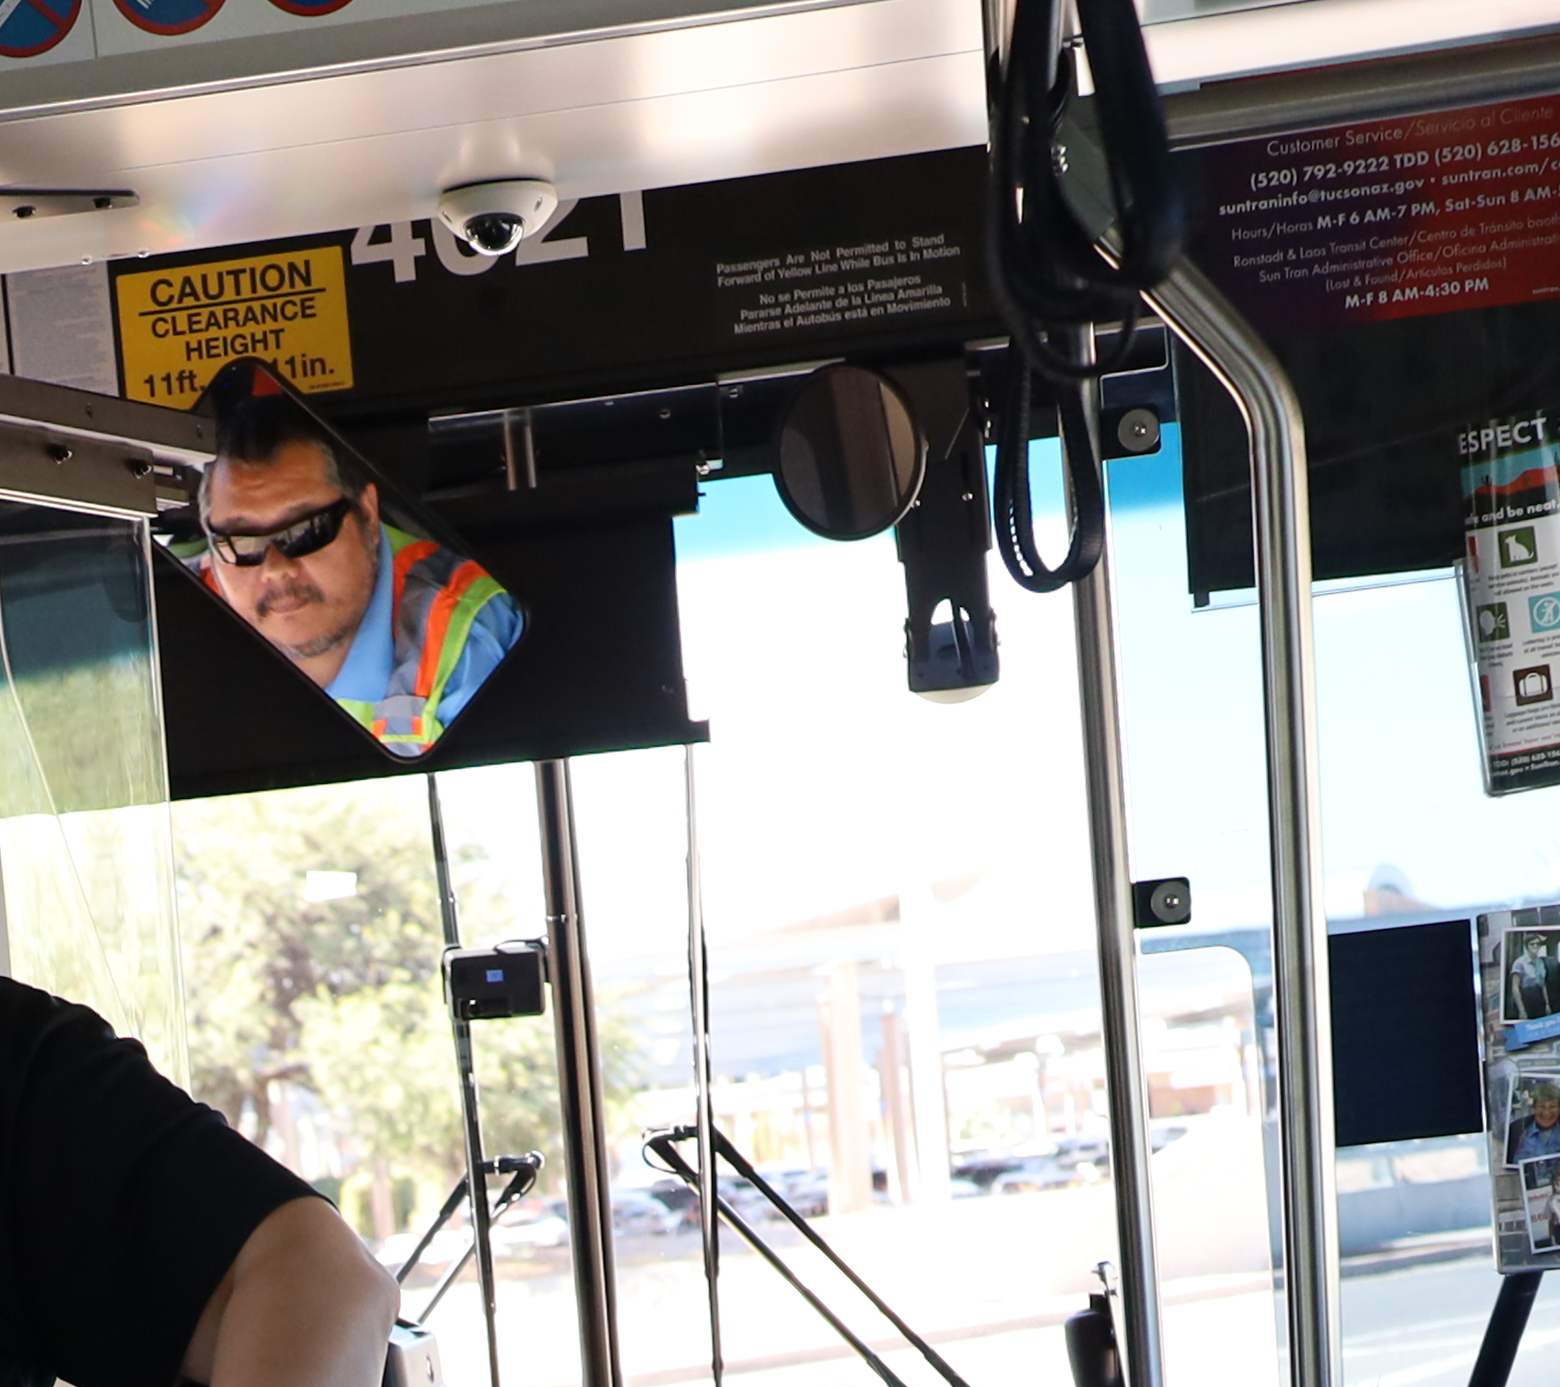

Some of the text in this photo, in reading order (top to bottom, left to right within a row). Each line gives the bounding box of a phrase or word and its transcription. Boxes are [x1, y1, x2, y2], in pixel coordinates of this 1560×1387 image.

[1267, 116, 1475, 155] Customer Service/Servicio
[1250, 168, 1296, 191] (520)
[1303, 156, 1388, 180] 792-9222
[1393, 151, 1428, 168] TDD
[1435, 142, 1481, 166] (520)
[1219, 179, 1423, 214] suntraninfo@tucsonaz.gov
[1231, 221, 1314, 241] Hours/Horas
[1317, 213, 1344, 229] M-F
[1349, 211, 1359, 224] 6
[1363, 204, 1406, 222] AM-7
[1411, 201, 1439, 216] PM,
[1445, 194, 1505, 211] Sat-Sun
[1510, 190, 1518, 202] 8
[716, 234, 945, 274] Passengers Are Not Permitted to Stand
[717, 246, 960, 286] Forward of Yellow Line While Bus Is In Motion
[151, 259, 313, 307] CAUTION
[151, 297, 317, 339] CLEARANCE
[185, 328, 285, 361] HEIGHT
[144, 370, 207, 398] 11ft.
[1458, 417, 1548, 455] ESPECT
[1482, 506, 1504, 523] and
[1507, 504, 1524, 518] be
